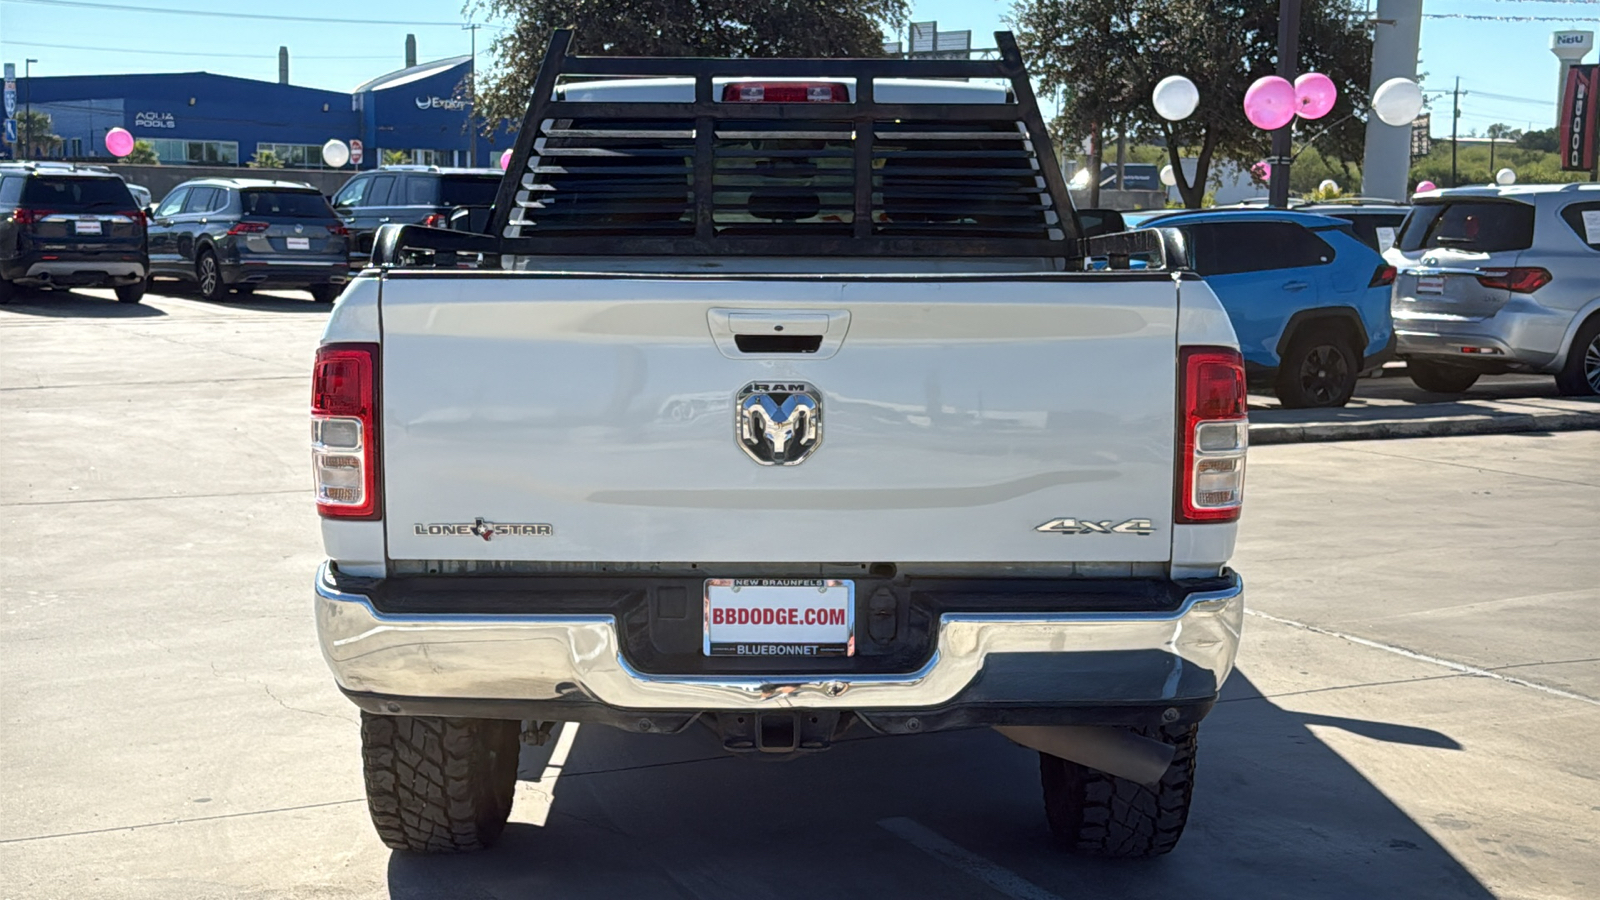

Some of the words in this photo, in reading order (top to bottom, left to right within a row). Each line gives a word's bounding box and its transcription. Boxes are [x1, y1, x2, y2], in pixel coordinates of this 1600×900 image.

[136, 112, 174, 120] AQUA
[135, 120, 175, 128] POOLS
[1571, 83, 1585, 167] DODGE
[414, 524, 471, 535] LONE
[494, 524, 553, 535] STAR
[712, 608, 846, 625] BBDODGE.COM
[736, 645, 819, 655] BLUEBONNET
